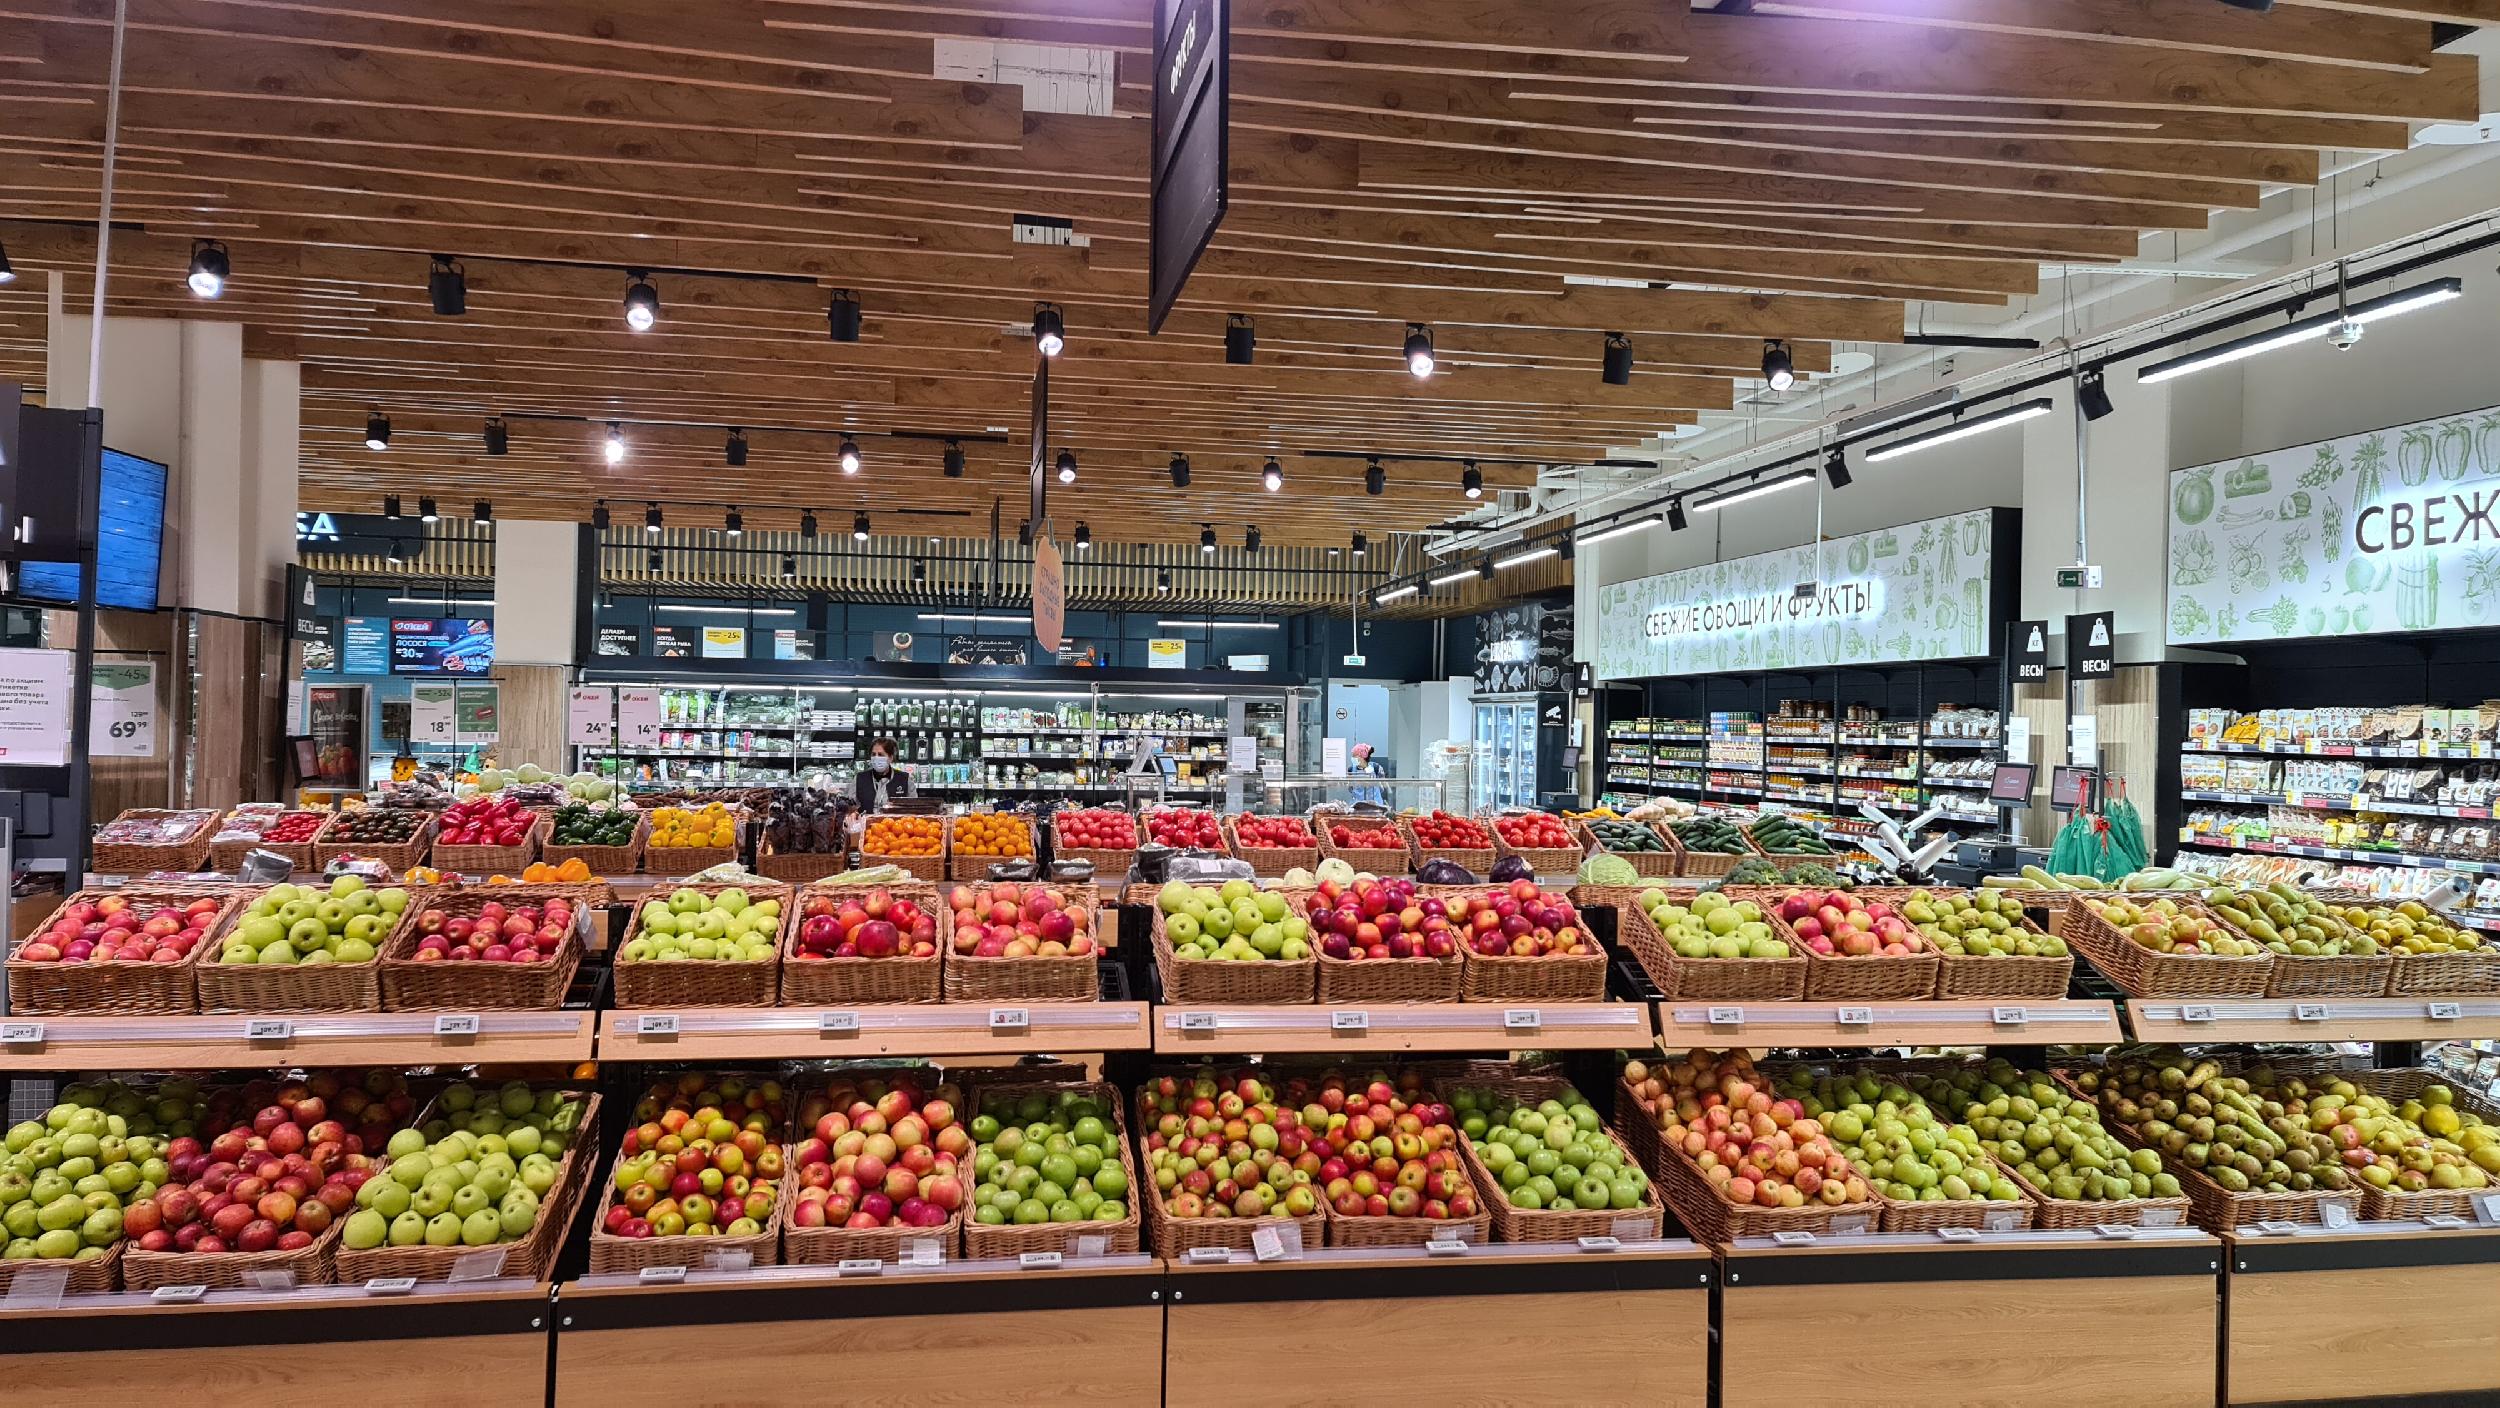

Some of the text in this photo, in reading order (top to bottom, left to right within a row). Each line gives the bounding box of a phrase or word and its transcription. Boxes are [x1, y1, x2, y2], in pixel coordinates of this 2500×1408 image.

[1645, 581, 1872, 638] СВЕЖИЕ ОВОЩИ И ФРУКТЫ
[396, 639, 427, 647] ЛОСОСЯ
[2019, 664, 2043, 677] ВЕСЫ
[2082, 659, 2110, 673] ВЕСЫ
[109, 721, 137, 738] 69
[430, 722, 444, 733] 18
[585, 722, 602, 734] 24
[637, 724, 651, 735] 14
